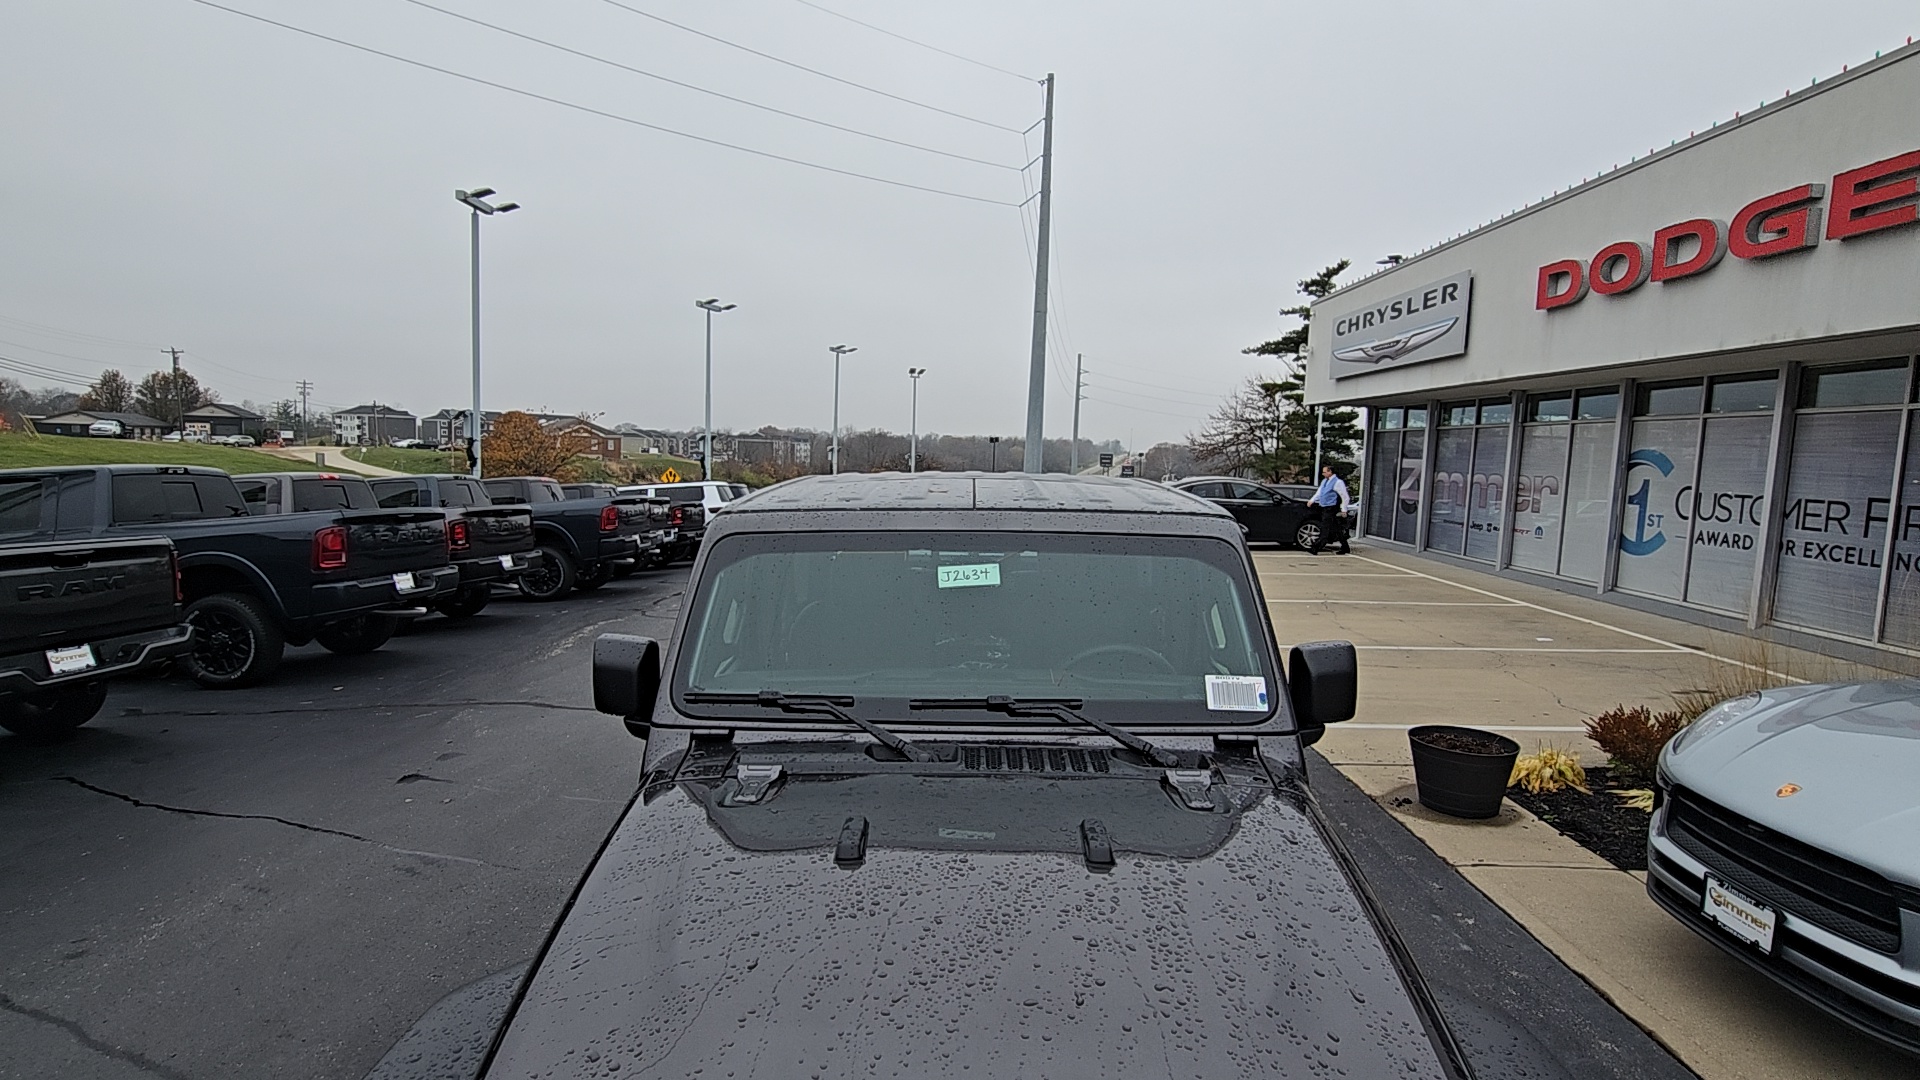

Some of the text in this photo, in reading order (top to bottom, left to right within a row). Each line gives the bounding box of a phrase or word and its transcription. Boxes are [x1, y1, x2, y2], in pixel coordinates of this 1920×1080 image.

[1536, 150, 1920, 310] DODGE
[1336, 282, 1459, 336] CHRYSLER
[1399, 458, 1559, 514] Zmmer
[1694, 530, 1754, 551] AWARD
[1803, 541, 1920, 573] EXCELLN
[17, 575, 125, 601] RAM
[940, 567, 991, 583] J2634
[1712, 888, 1772, 932] Zimmer
[1722, 881, 1757, 906] Zimmer
